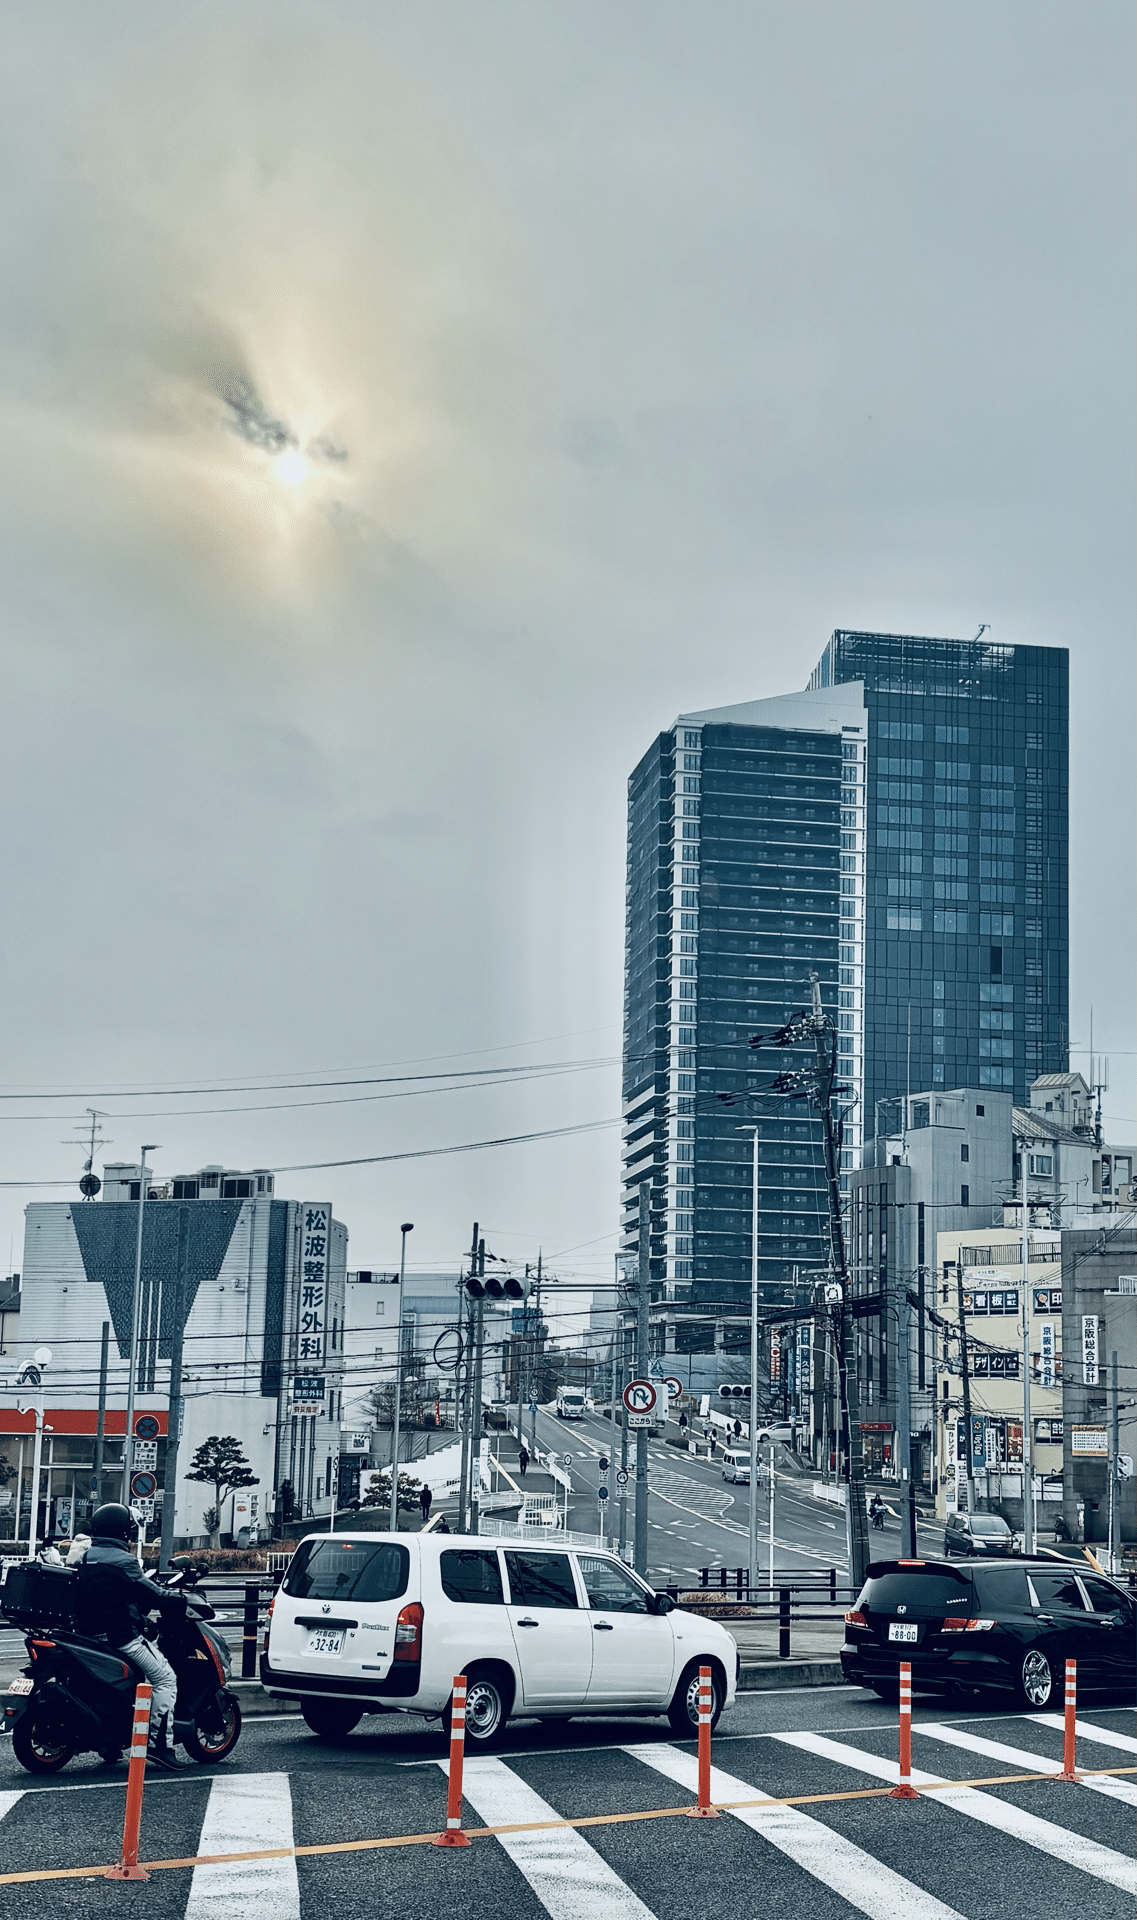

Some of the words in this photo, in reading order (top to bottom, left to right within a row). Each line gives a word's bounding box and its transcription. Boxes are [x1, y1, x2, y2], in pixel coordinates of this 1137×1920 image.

[301, 1209, 326, 1359] 松波整形外科
[975, 1356, 1004, 1368] デザイン
[1043, 1326, 1052, 1385] 京阪総合会計
[1085, 1318, 1095, 1383] 京阪総合会計
[314, 1638, 340, 1652] 32-84
